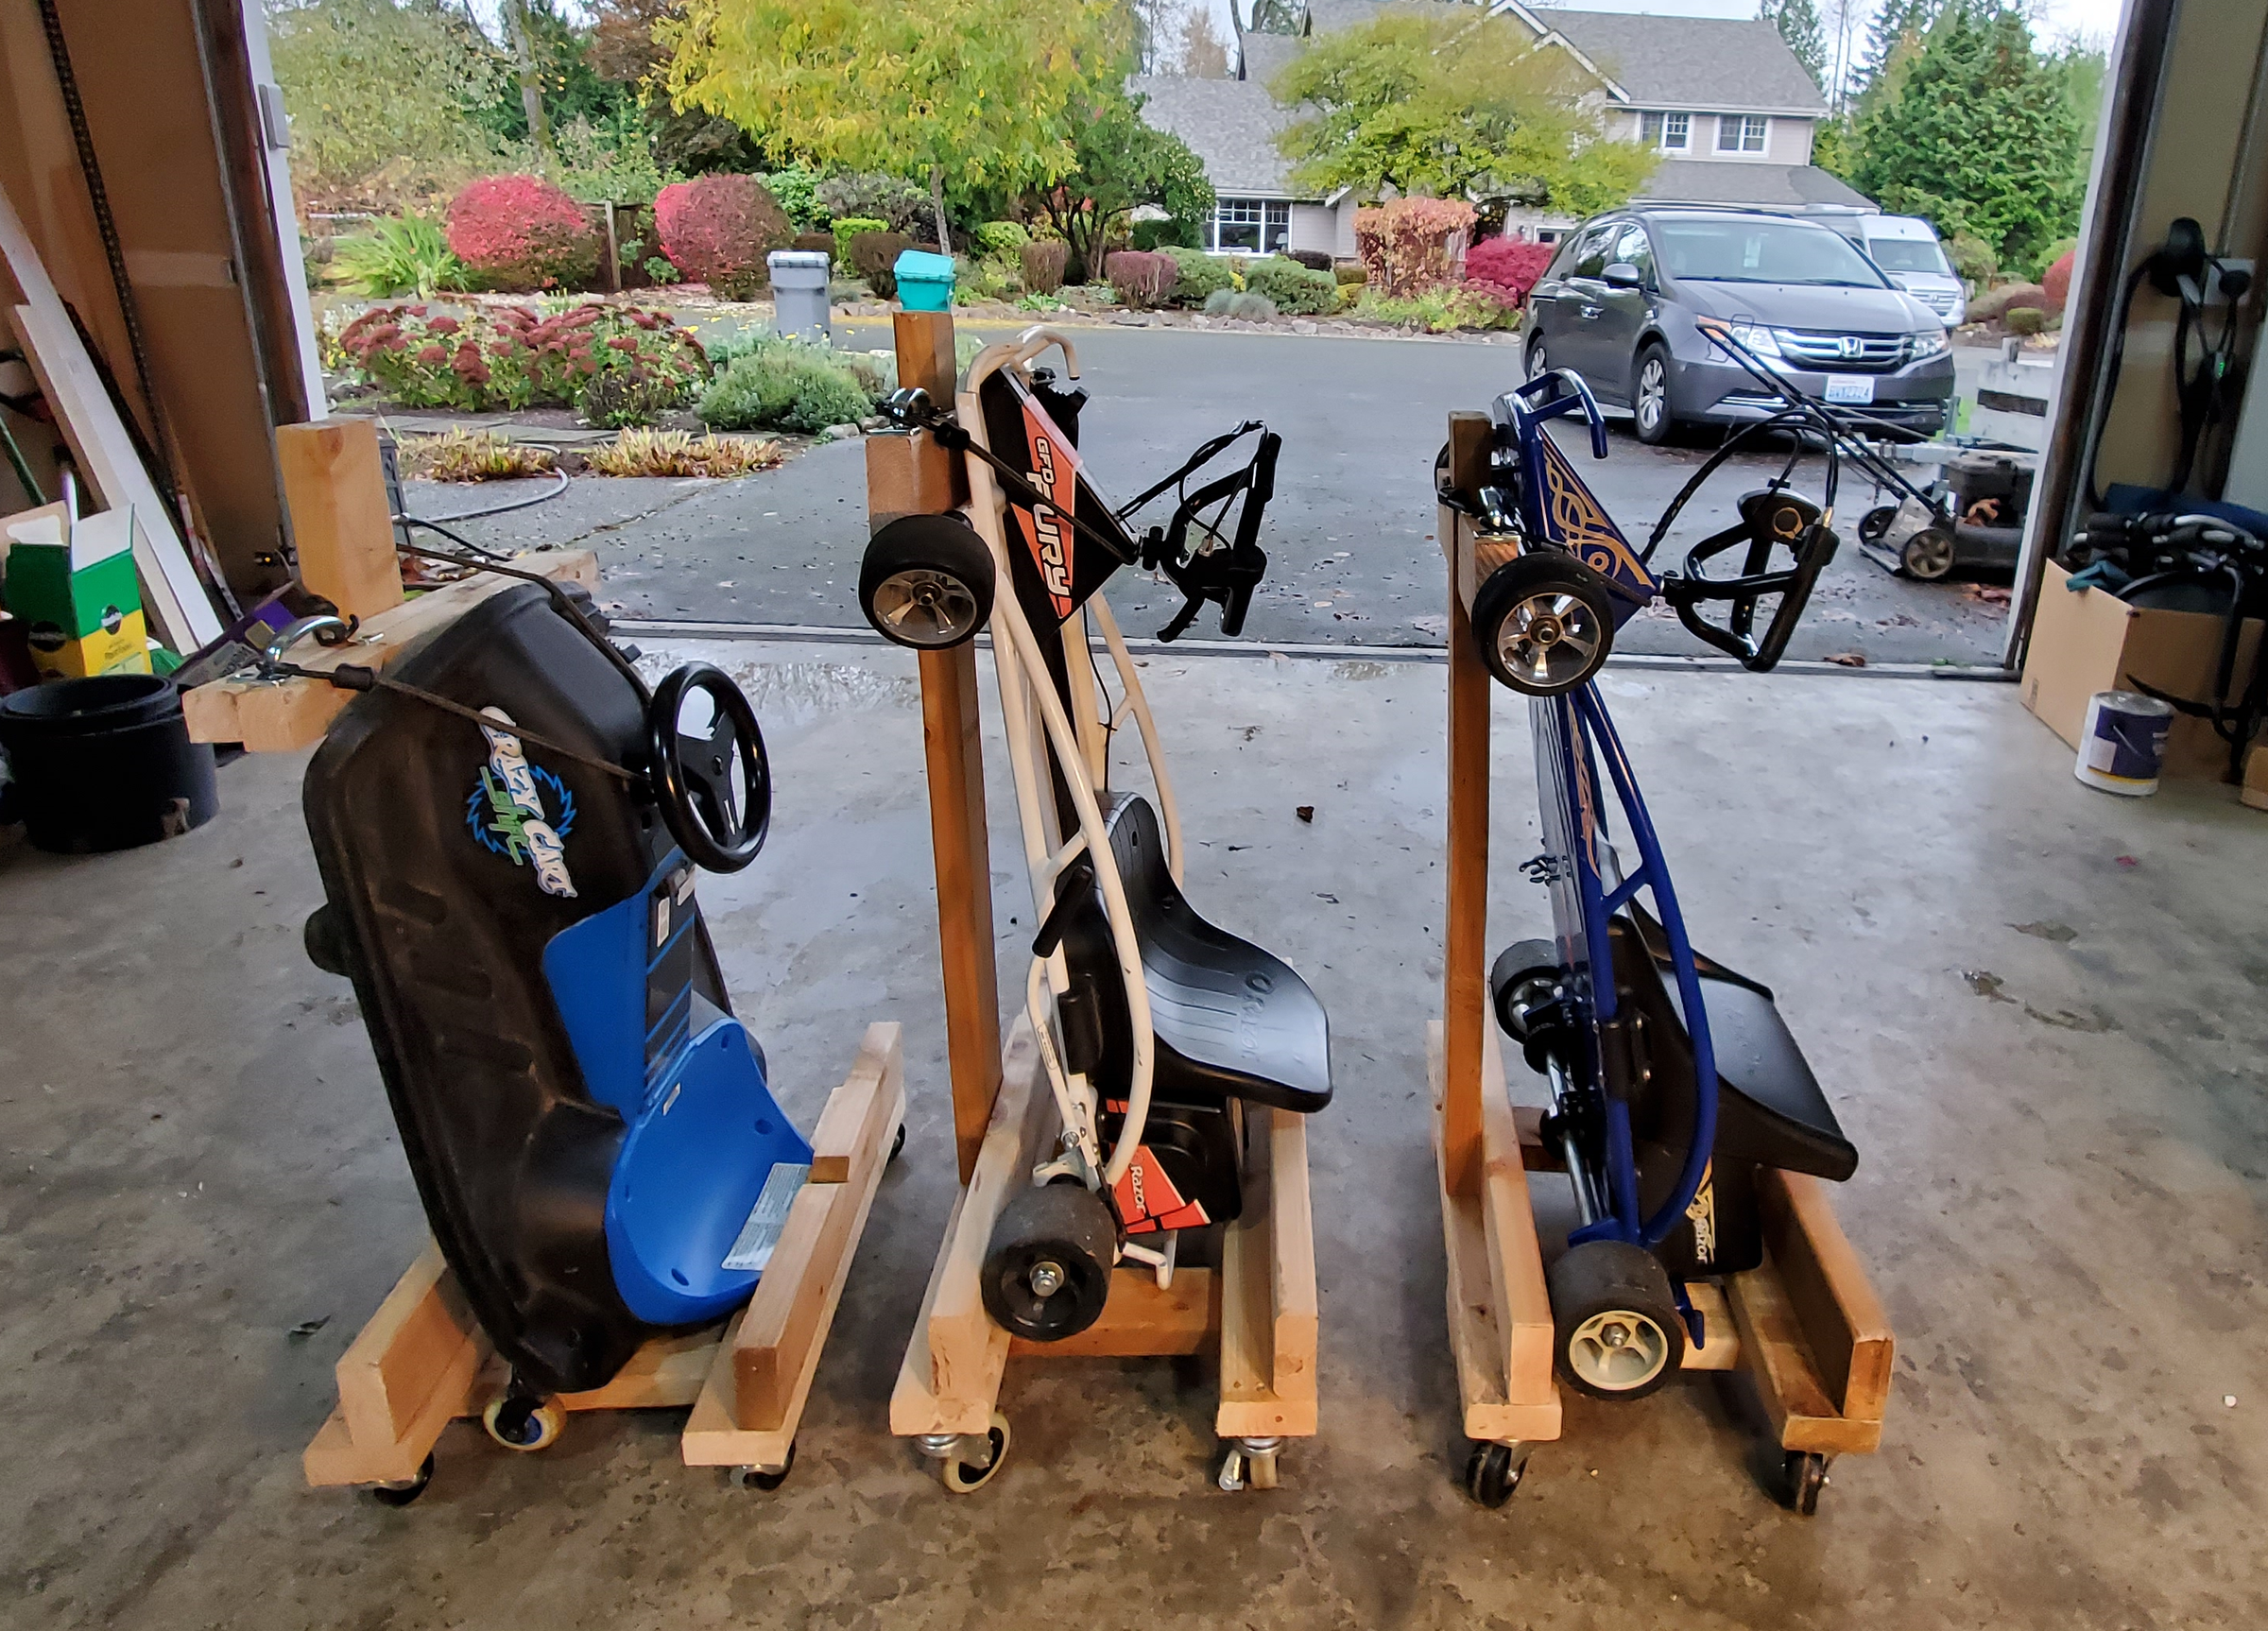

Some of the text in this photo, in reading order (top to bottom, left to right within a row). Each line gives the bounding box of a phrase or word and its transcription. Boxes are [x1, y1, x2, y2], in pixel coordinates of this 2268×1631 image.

[1026, 472, 1071, 596] FURY
[521, 818, 578, 898] CART
[1129, 1164, 1146, 1214] Razor
